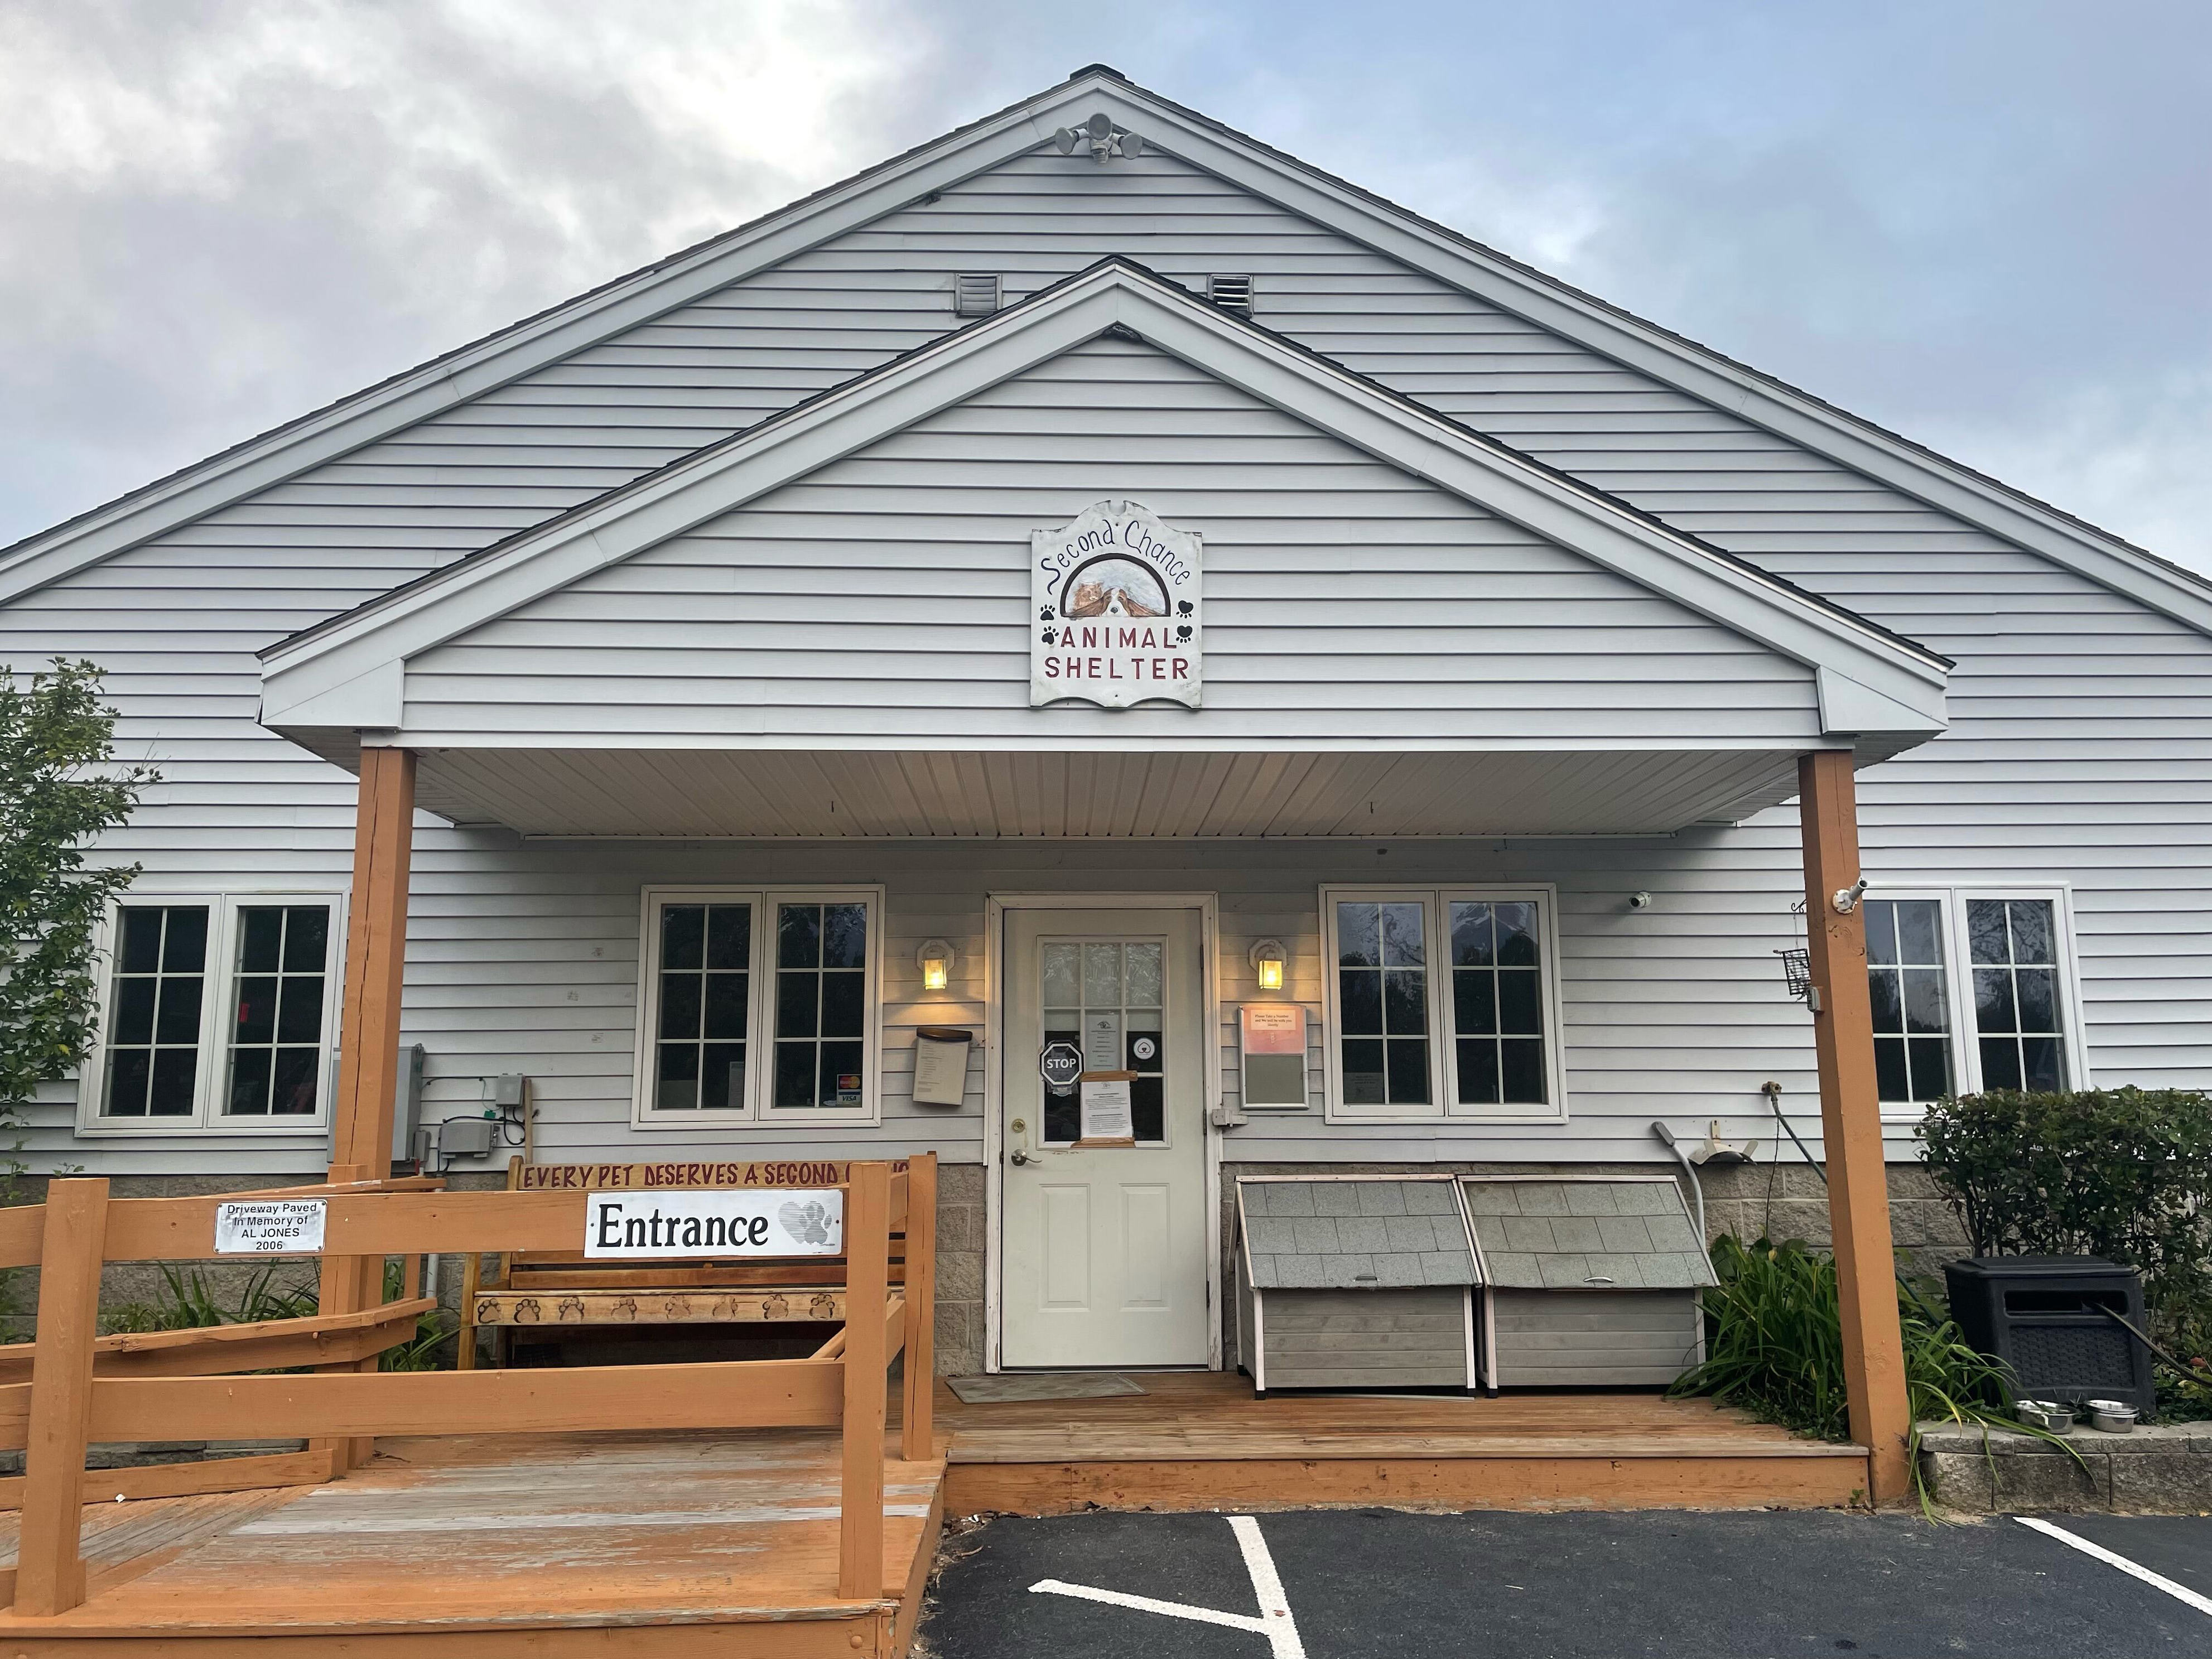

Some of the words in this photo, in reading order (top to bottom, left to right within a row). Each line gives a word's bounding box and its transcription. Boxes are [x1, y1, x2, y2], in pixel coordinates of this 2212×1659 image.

[1040, 519, 1115, 595] Second
[1125, 520, 1190, 585] Chance
[1061, 626, 1177, 648] ANIMAL
[1044, 657, 1189, 679] SHELTER
[1047, 1058, 1077, 1069] STOP
[524, 1166, 593, 1188] EVERY
[598, 1164, 634, 1187] PET
[644, 1163, 738, 1186] DESERVES
[744, 1164, 758, 1185] A
[764, 1162, 838, 1185] SECOND
[228, 1204, 278, 1214] Driveway
[283, 1203, 317, 1212] Paved
[234, 1217, 243, 1226] In
[247, 1216, 293, 1227] Memory
[297, 1216, 308, 1224] of
[596, 1203, 769, 1247] Entrance
[241, 1229, 257, 1238] AL
[261, 1228, 300, 1237] JONES
[256, 1241, 283, 1250] 2006
